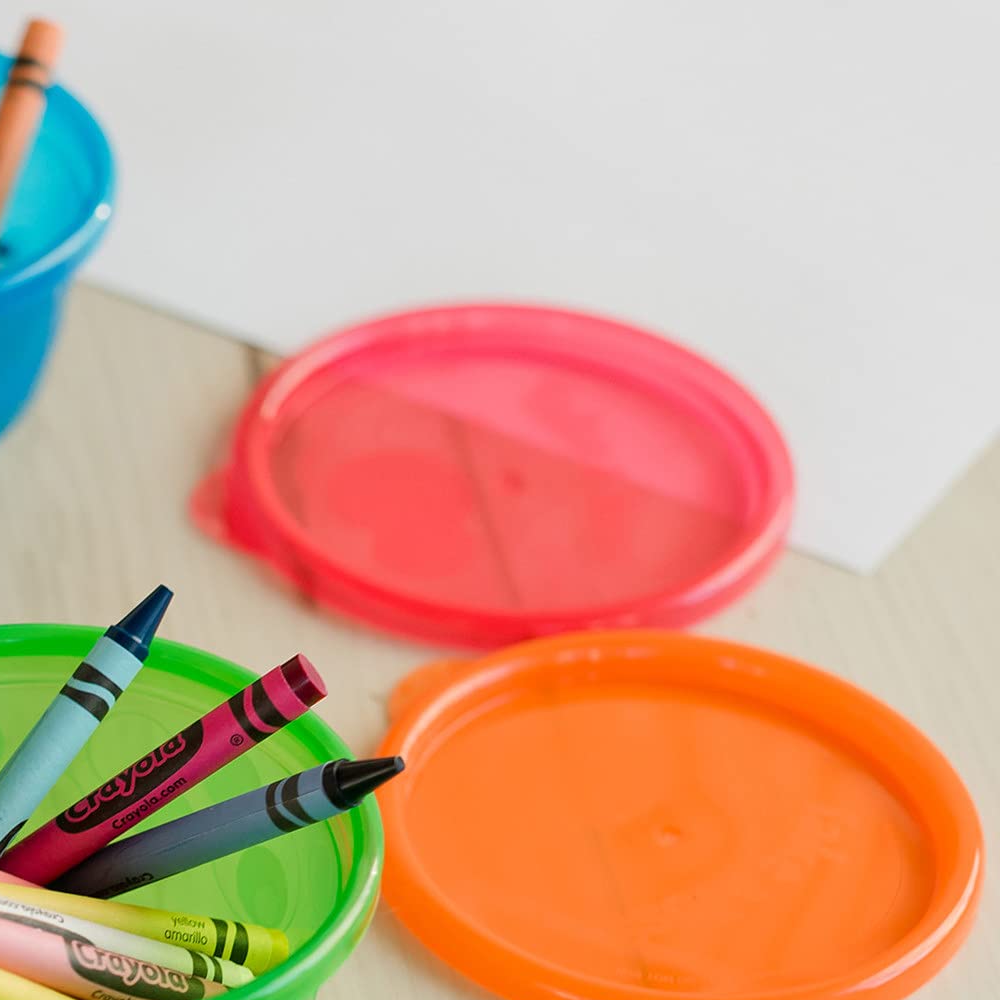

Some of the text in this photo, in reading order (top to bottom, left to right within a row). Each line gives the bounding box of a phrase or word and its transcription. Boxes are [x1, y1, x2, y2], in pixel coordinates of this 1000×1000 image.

[64, 733, 186, 823] Crayola
[112, 776, 187, 829] Crayola.com
[164, 929, 208, 945] amarillo
[72, 940, 188, 993] Crayola
